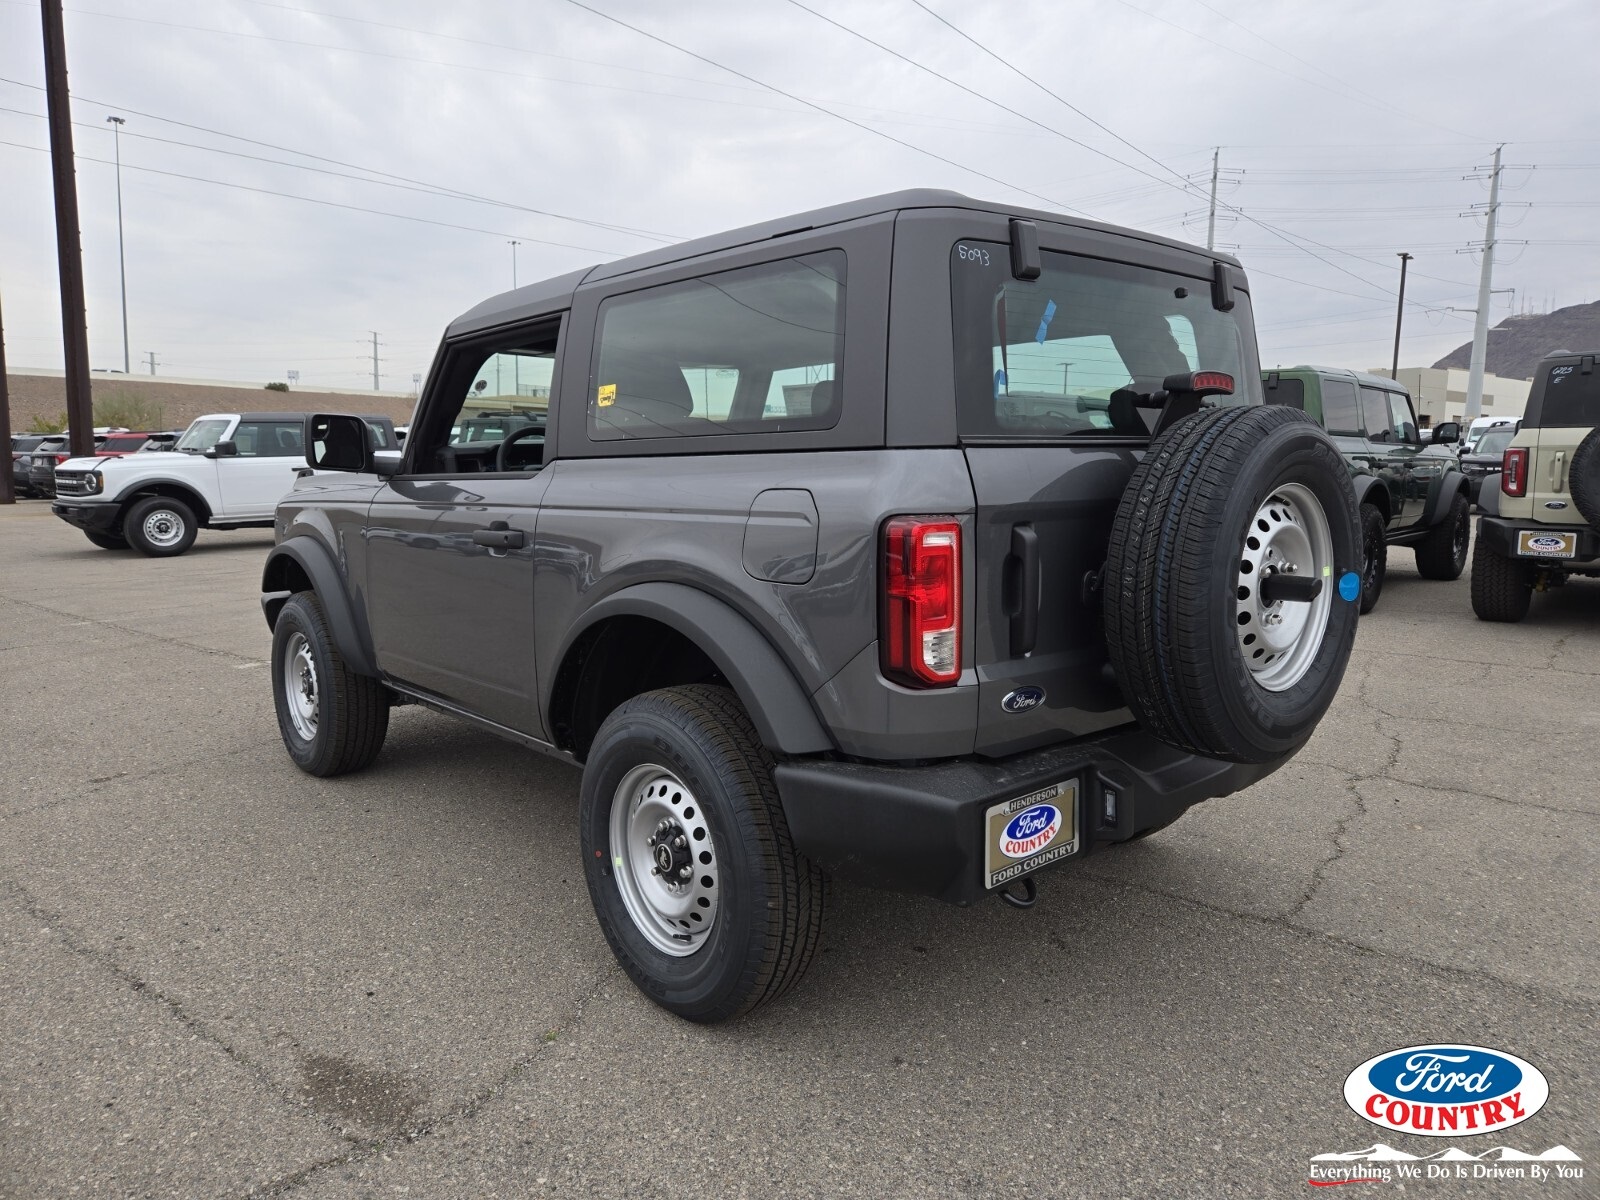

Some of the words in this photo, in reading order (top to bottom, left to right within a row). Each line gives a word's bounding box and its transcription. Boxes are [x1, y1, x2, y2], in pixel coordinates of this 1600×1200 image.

[1013, 694, 1037, 709] Ford
[1010, 787, 1057, 811] HENDERSON
[1005, 822, 1056, 854] COUNTRY
[1015, 809, 1047, 838] Ford
[992, 864, 1022, 884] FORD
[1023, 843, 1073, 870] COUNTRY
